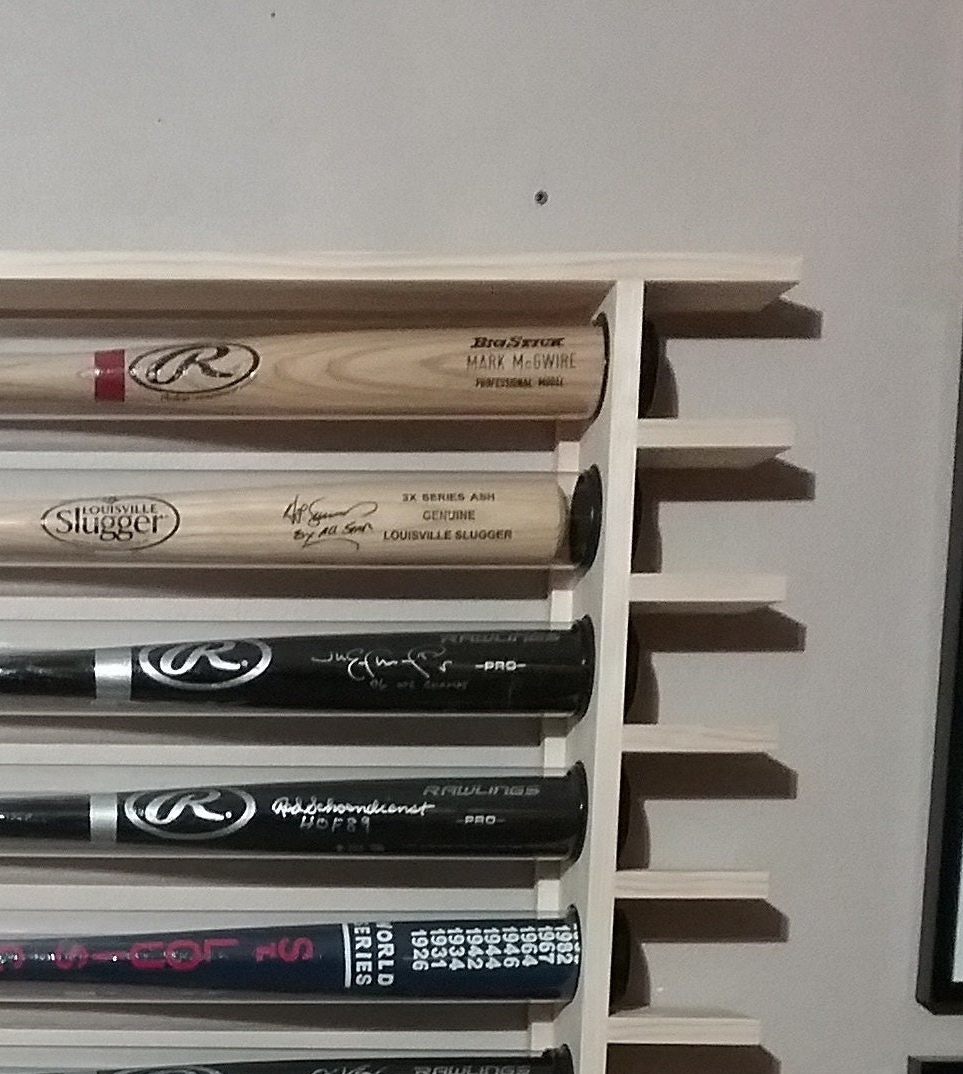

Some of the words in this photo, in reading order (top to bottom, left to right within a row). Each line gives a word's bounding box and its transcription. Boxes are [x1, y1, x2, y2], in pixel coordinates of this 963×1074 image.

[466, 354, 505, 370] MARK
[82, 503, 158, 515] LOUISVILLE
[422, 493, 465, 501] SERIES
[470, 493, 495, 501] ASH
[422, 510, 476, 521] GENUINE
[56, 507, 163, 541] Slugger
[383, 530, 452, 540] LOUISVILLE
[455, 530, 513, 540] SLUGGER
[423, 785, 540, 796] RAWLINGS
[353, 921, 373, 987] ERIES
[410, 929, 430, 971] 1926
[430, 928, 448, 969] 1931
[447, 927, 466, 971] 1934
[466, 927, 484, 970] 1942
[483, 927, 502, 970] 1944
[502, 926, 521, 969] 1946
[520, 925, 538, 967] 1964
[537, 925, 555, 965] 1967
[554, 925, 574, 965] 1982
